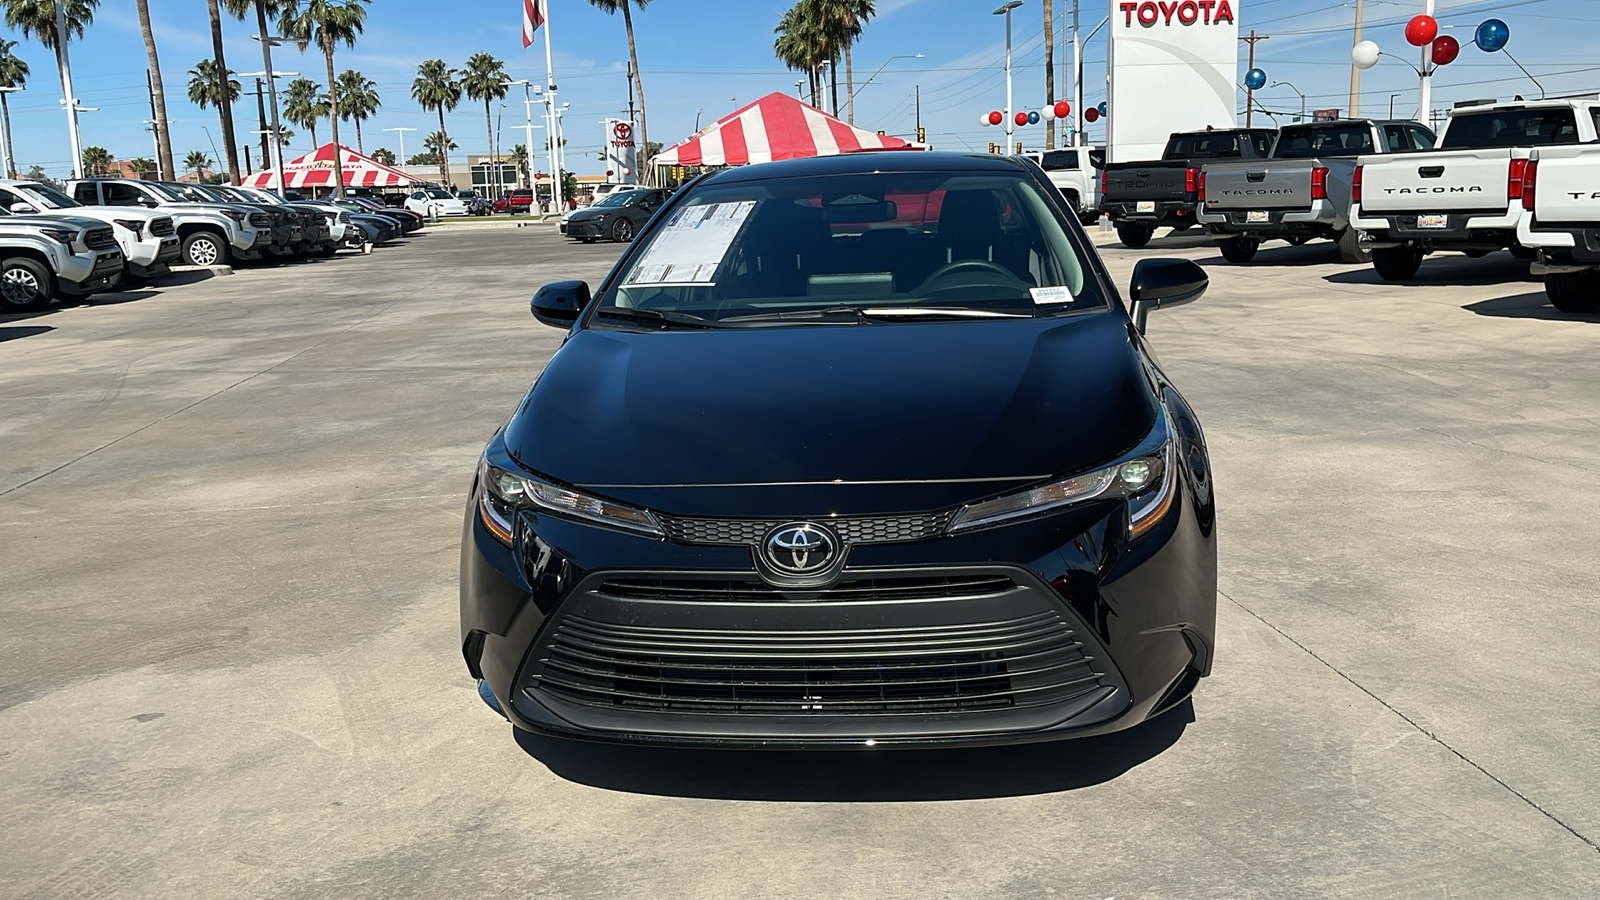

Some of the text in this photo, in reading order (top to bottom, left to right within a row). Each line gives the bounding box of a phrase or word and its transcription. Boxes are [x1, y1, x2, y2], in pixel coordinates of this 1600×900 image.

[1119, 0, 1235, 28] TOYOTA
[611, 140, 636, 148] TOYOTA
[1220, 188, 1294, 196] TACOMA
[1383, 185, 1483, 195] TACOMA
